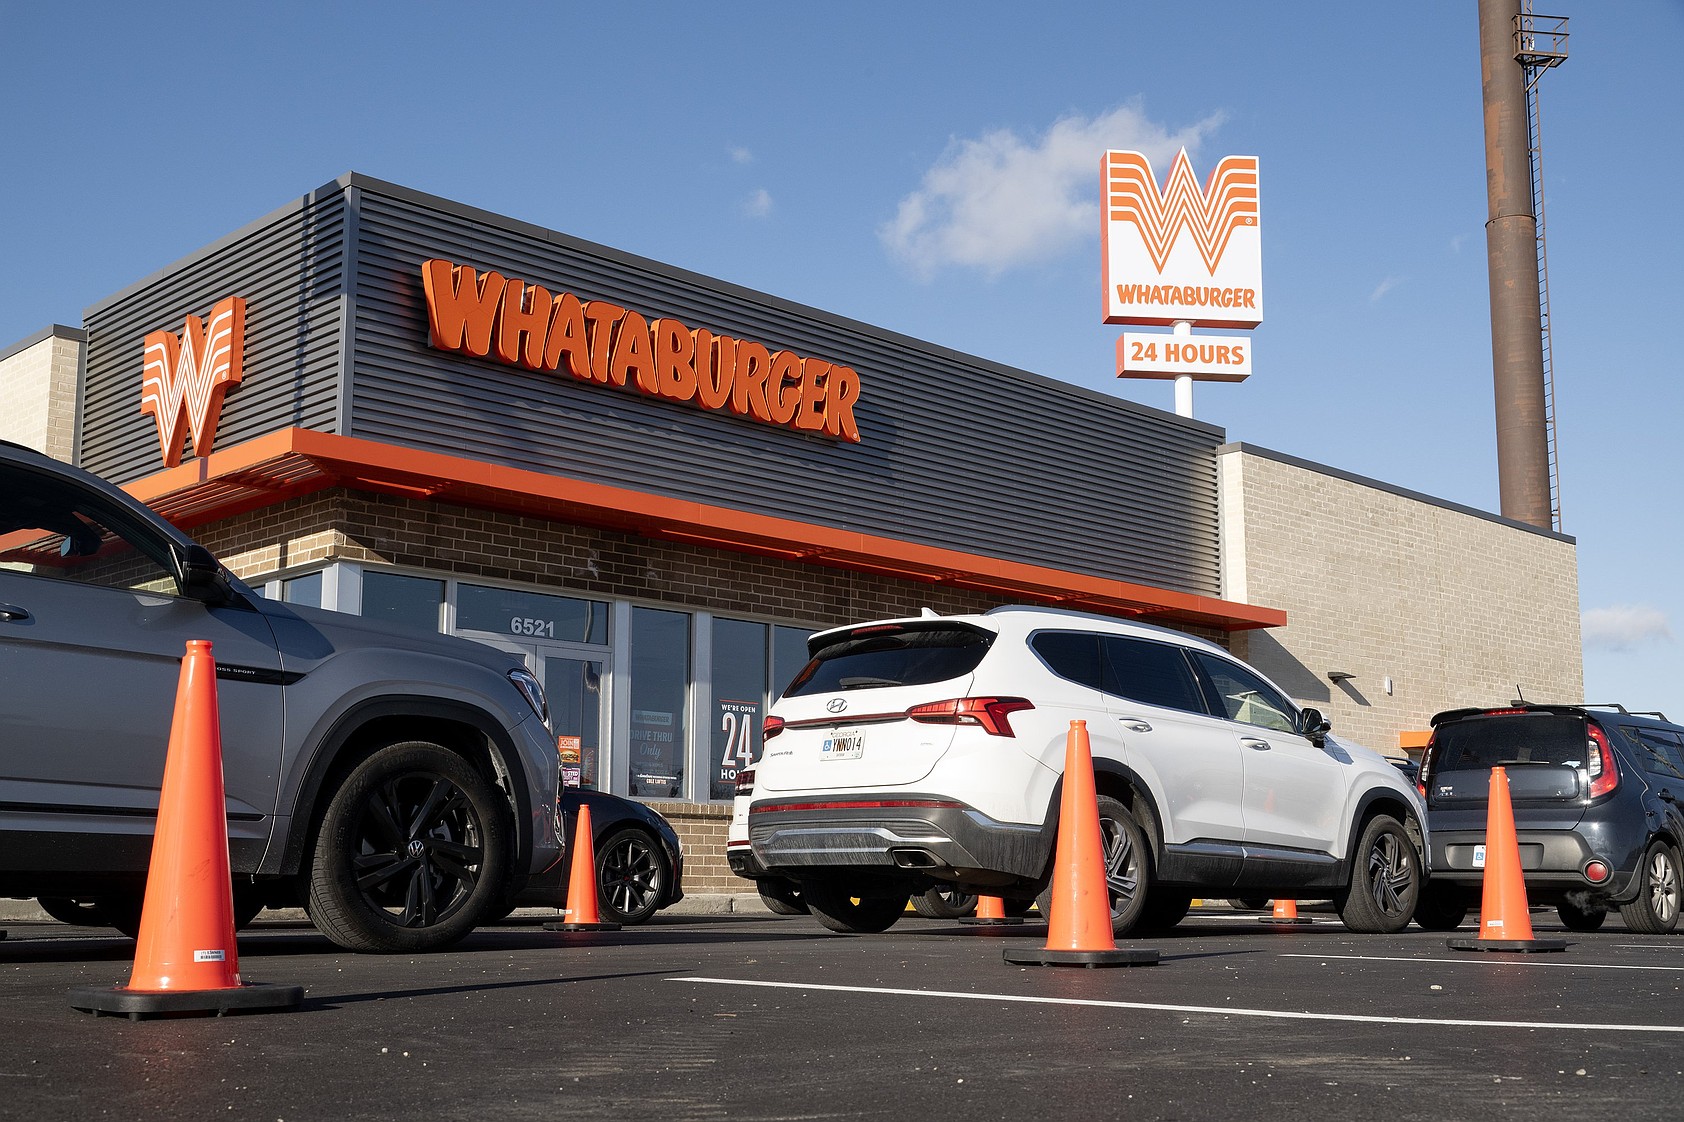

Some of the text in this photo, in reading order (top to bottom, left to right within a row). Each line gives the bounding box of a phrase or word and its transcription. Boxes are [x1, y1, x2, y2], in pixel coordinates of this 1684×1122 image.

[1116, 283, 1256, 310] WHATABURGER
[422, 258, 862, 443] WHATABURGER
[1131, 341, 1245, 365] 24 HOURS
[510, 616, 554, 638] 6521
[722, 704, 756, 714] WE'RE OPEN
[653, 731, 673, 743] THRU
[722, 712, 753, 768] 24
[641, 743, 662, 759] Only
